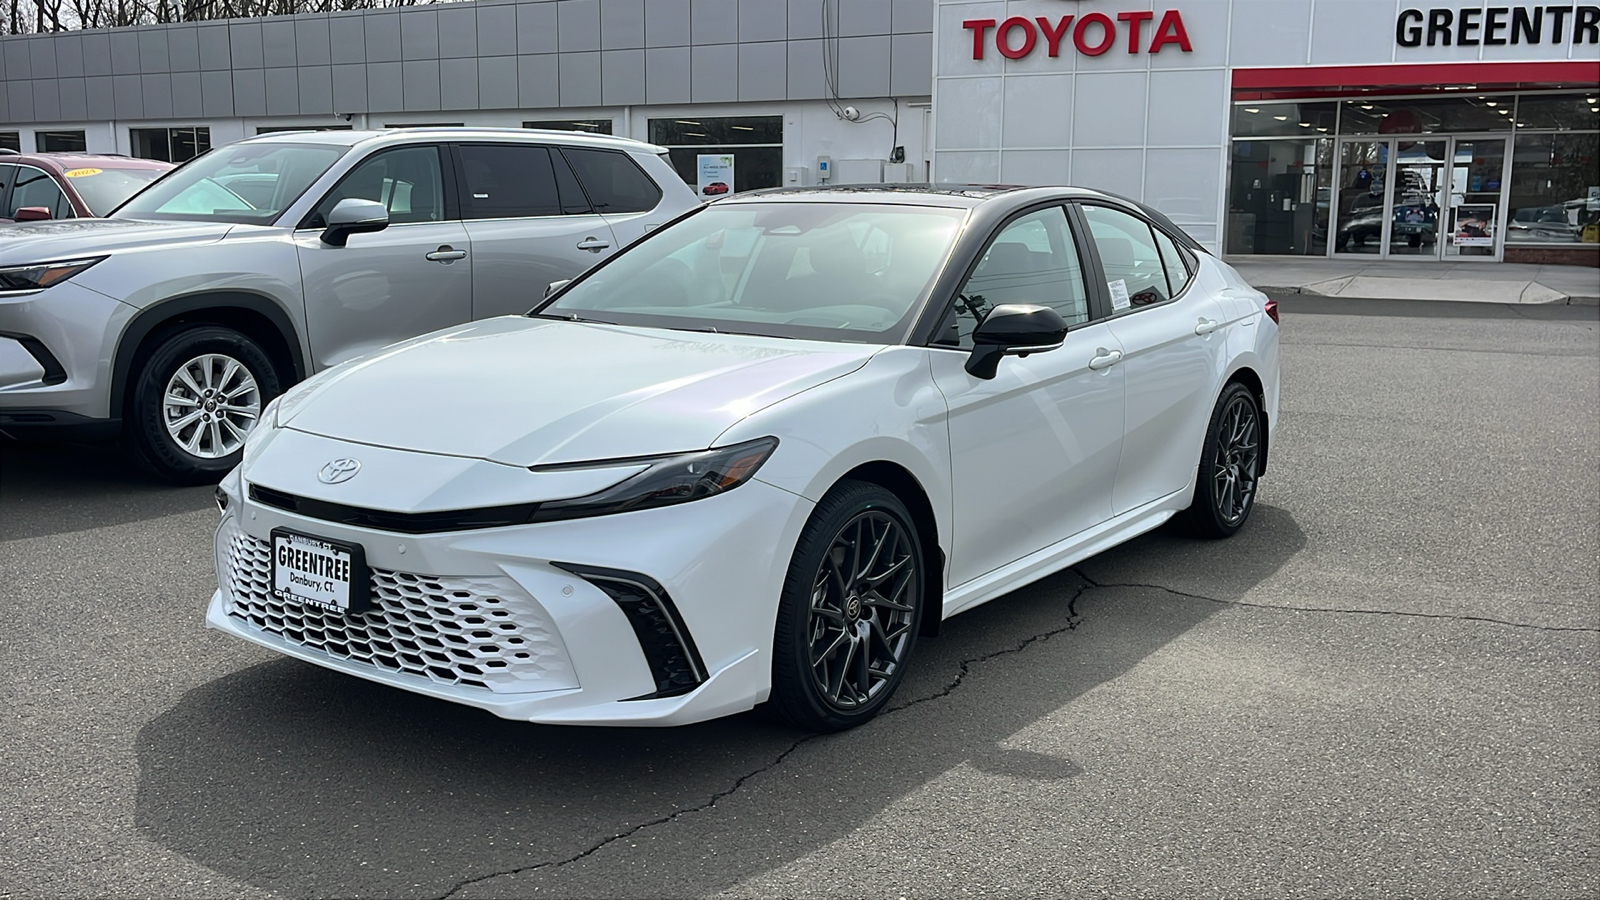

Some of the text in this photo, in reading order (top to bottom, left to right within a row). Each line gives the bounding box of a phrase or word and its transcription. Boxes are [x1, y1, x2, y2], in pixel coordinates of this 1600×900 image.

[962, 10, 1193, 60] TOYOTA
[1396, 6, 1600, 47] GREENTR
[72, 168, 96, 176] 2024
[278, 545, 349, 583] GREENTREE
[290, 571, 335, 593] Danbury, CT.
[274, 589, 345, 614] GREENTREE
